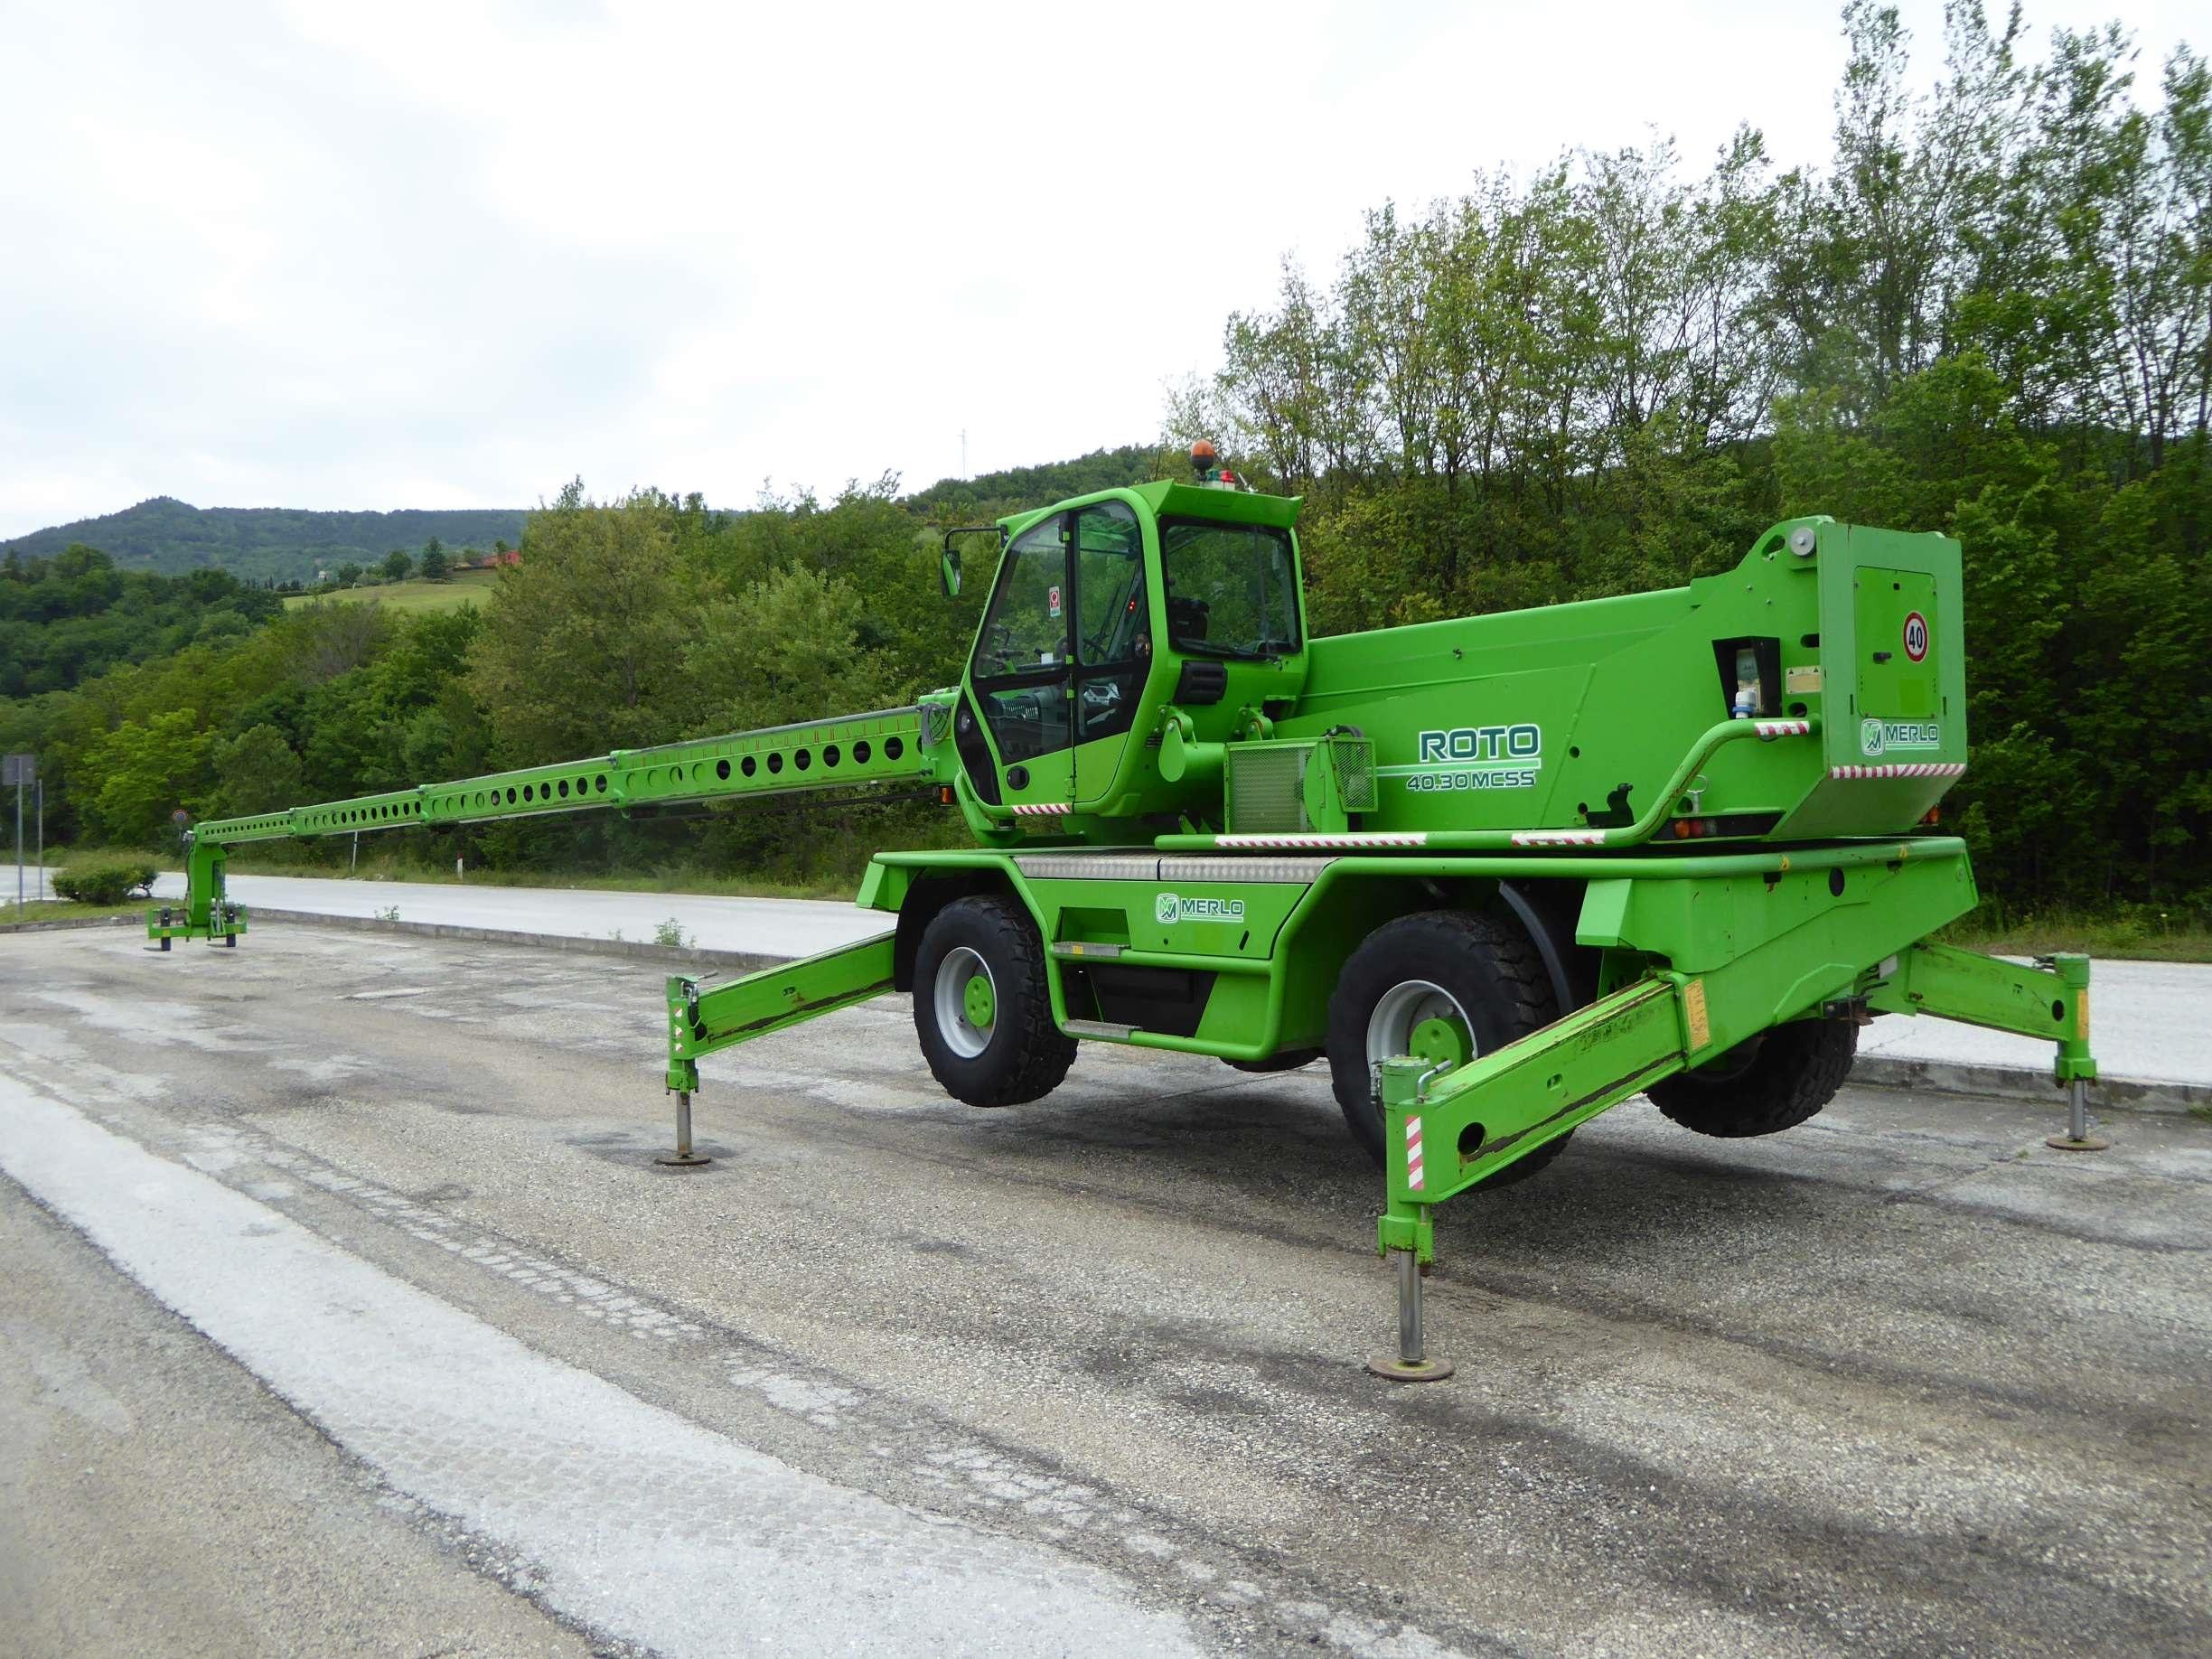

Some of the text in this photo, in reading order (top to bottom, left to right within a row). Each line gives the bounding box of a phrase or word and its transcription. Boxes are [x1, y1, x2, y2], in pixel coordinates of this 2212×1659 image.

[1908, 625, 1923, 649] 40
[1420, 724, 1541, 762] ROTO
[1885, 724, 1938, 742] MERLO
[1181, 898, 1243, 915] MERLO
